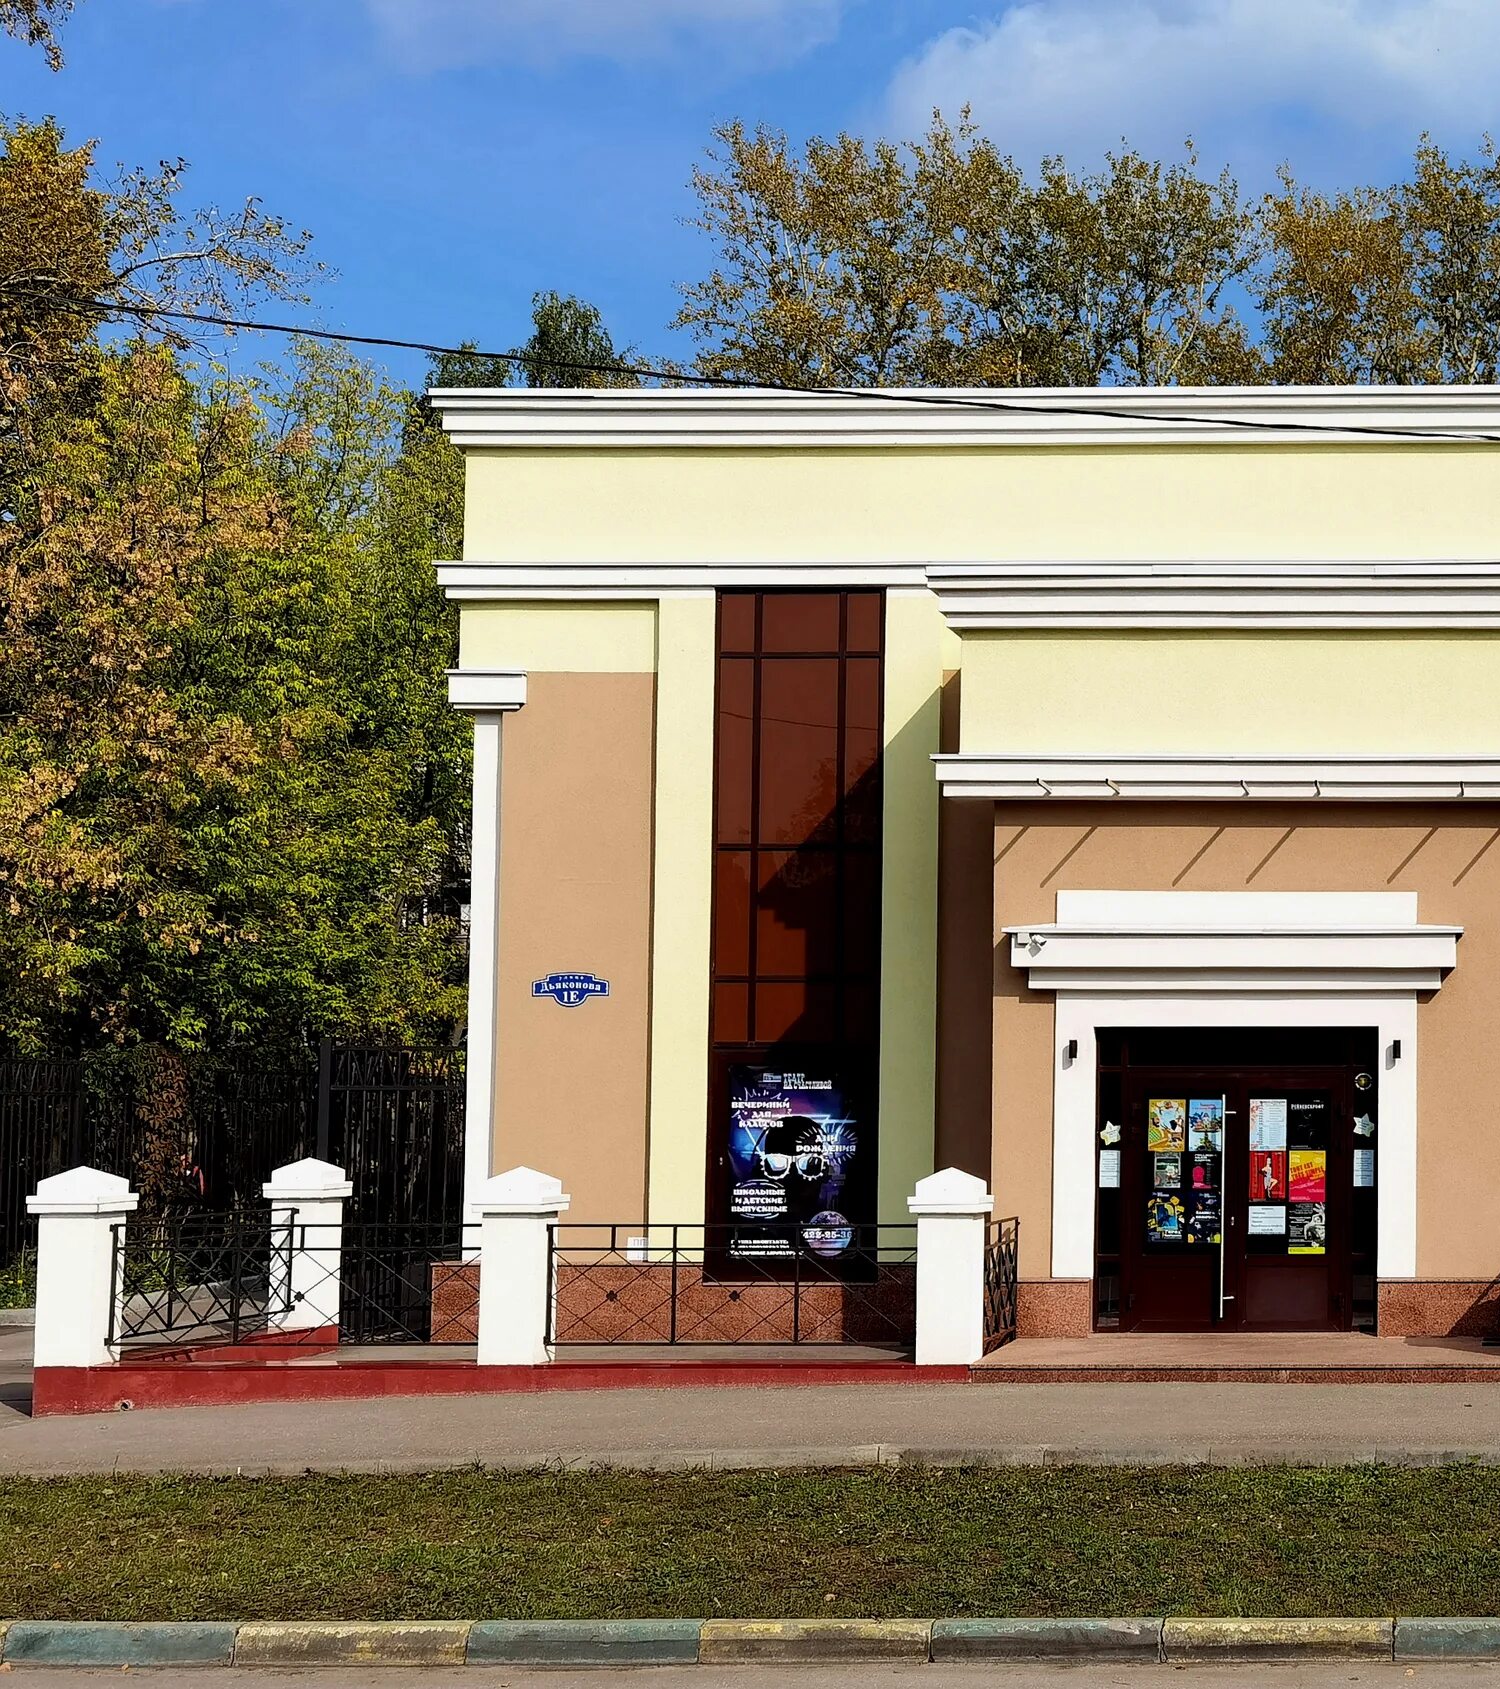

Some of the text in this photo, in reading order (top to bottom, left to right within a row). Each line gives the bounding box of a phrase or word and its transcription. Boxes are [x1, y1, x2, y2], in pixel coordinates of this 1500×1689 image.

[731, 1101, 790, 1109] ВЕЧЕРИНКИ
[738, 1120, 784, 1128] КЛАССОВ
[795, 1144, 857, 1153] РОЖДЕНИЯ
[743, 1197, 784, 1205] ДЕТСКИЕ
